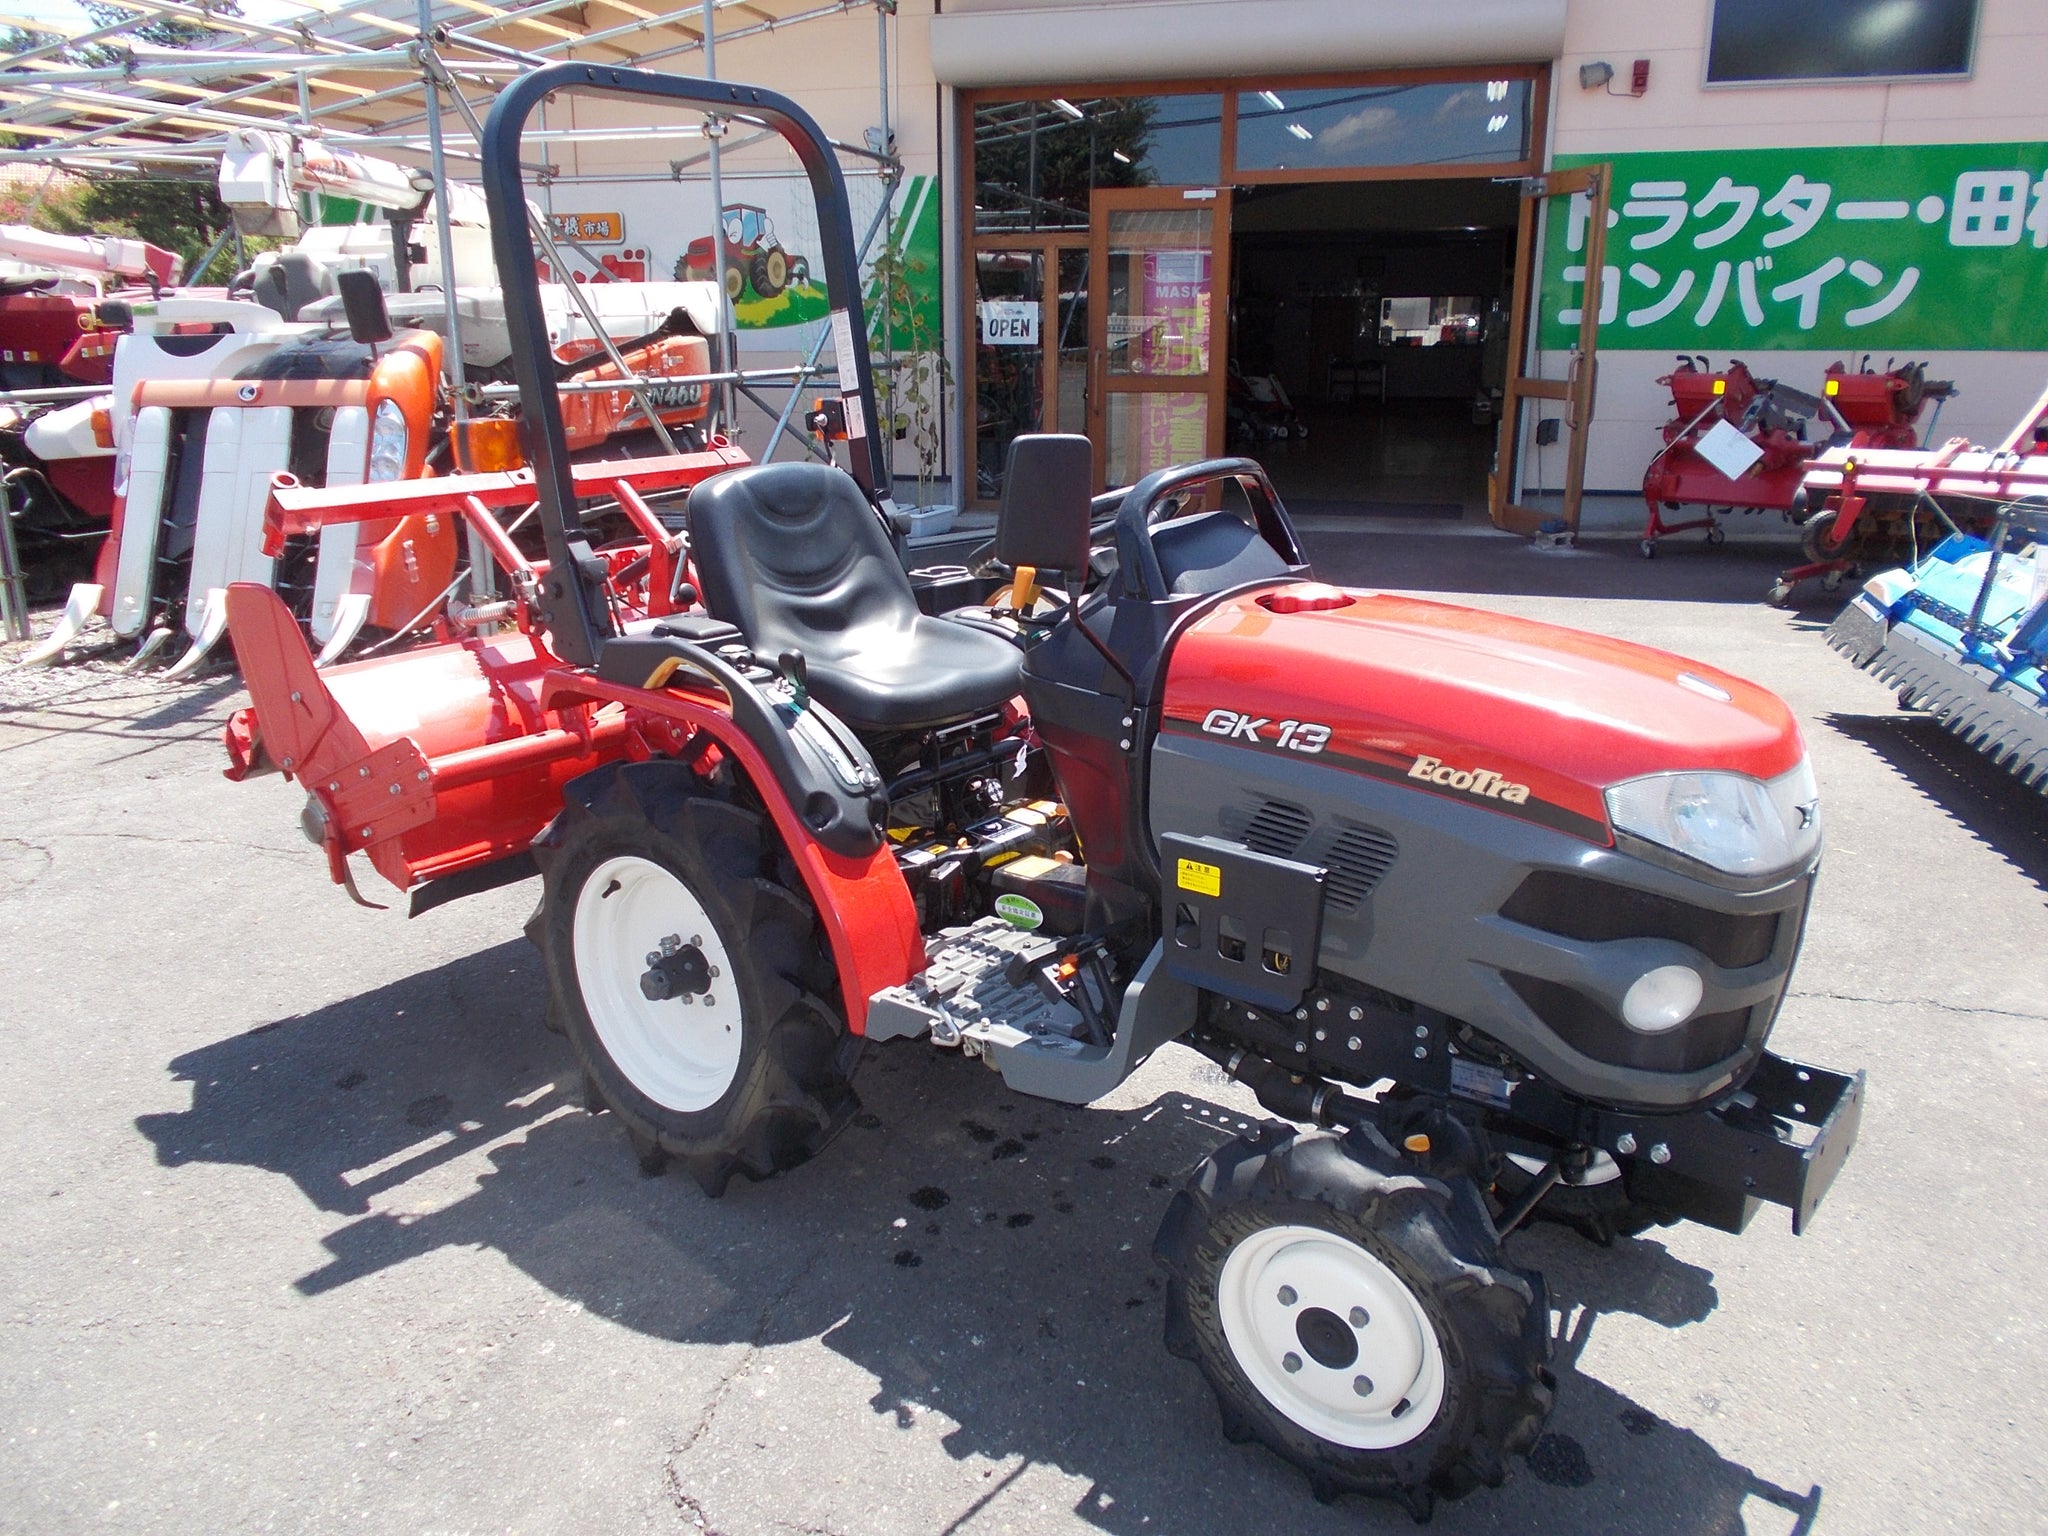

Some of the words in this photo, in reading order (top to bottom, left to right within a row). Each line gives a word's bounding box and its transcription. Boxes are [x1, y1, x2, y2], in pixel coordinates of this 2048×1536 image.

[1155, 285, 1203, 298] MASK
[1558, 256, 1920, 330] コンバイン
[989, 318, 1031, 338] OPEN
[1201, 708, 1271, 743] GK
[1275, 719, 1333, 754] 13
[1407, 754, 1531, 805] EcoTra
